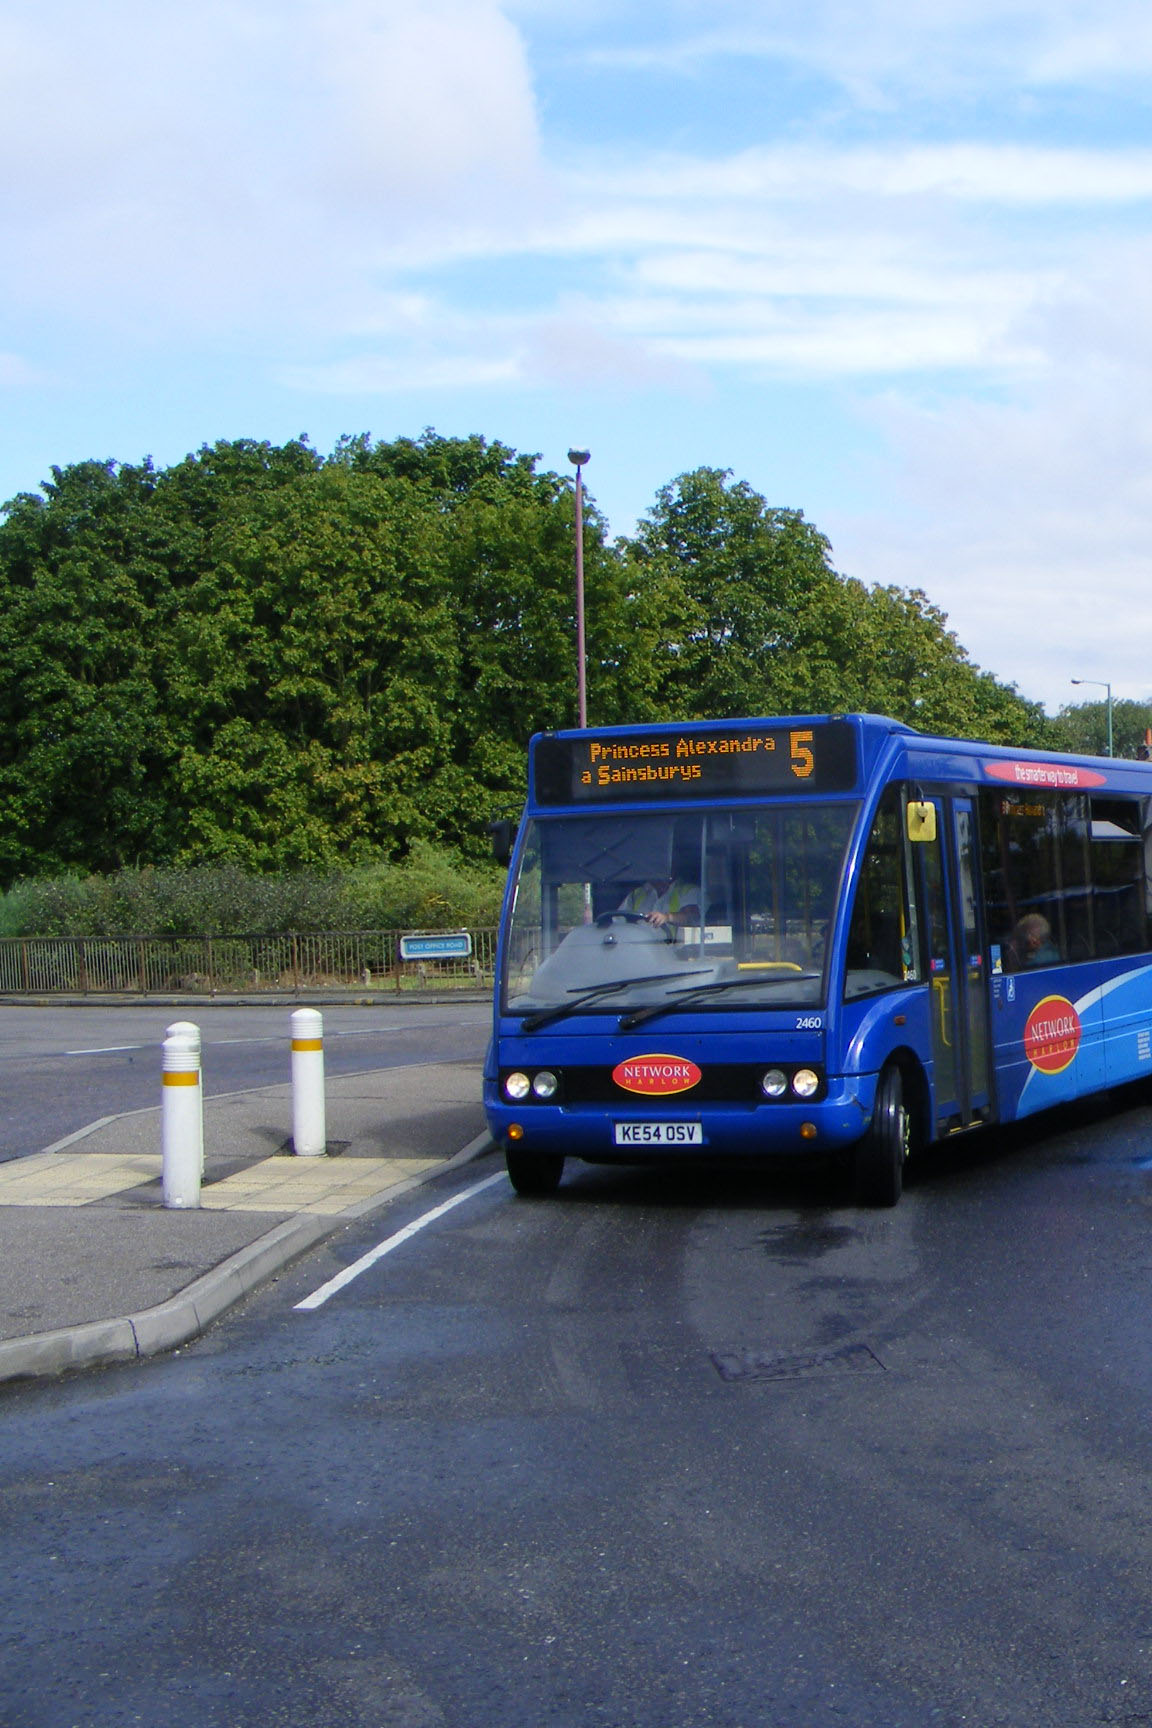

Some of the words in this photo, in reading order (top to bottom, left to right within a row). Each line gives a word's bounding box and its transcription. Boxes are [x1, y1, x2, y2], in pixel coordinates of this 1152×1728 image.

[590, 743, 670, 762] Princess
[677, 737, 775, 758] Alexandra
[790, 731, 814, 777] 5
[599, 763, 701, 785] Sainsburys
[424, 942, 445, 950] OFFICE
[446, 941, 463, 949] ROAD
[796, 1017, 821, 1029] 2460
[1031, 1016, 1075, 1043] NETWORK
[624, 1065, 690, 1078] NETWORK
[625, 1078, 690, 1086] HARLOW
[622, 1125, 662, 1141] KE54
[666, 1125, 695, 1141] OSV
